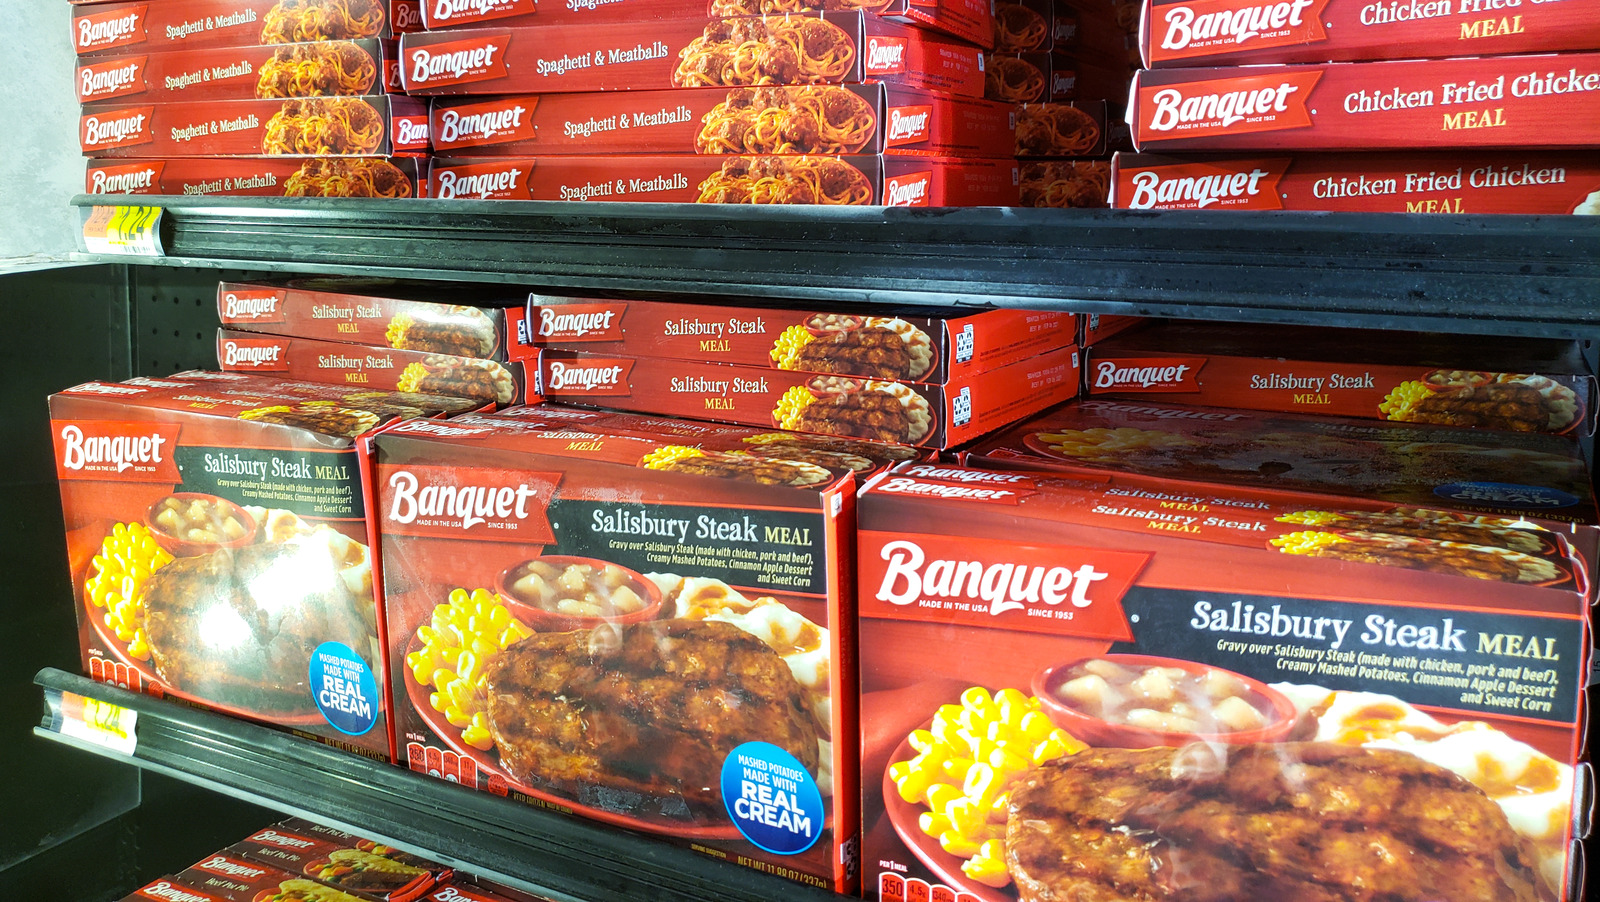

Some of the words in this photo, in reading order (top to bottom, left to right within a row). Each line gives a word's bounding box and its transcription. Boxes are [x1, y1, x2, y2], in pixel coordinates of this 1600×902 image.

[166, 20, 204, 40] Spaghetti
[206, 17, 213, 30] &
[215, 8, 257, 28] Meatballs
[1161, 0, 1314, 49] Banquet
[1360, 0, 1452, 26] Chicken
[79, 14, 138, 47] Banquet
[1458, 16, 1525, 40] MEAL
[412, 44, 498, 82] Banquet
[536, 53, 591, 77] Spaghetti
[594, 50, 605, 66] &
[608, 41, 668, 64] Meatballs
[867, 39, 903, 70] Banquet
[81, 64, 138, 96] Banquet
[165, 70, 201, 90] Spaghetti
[203, 69, 210, 81] &
[212, 61, 252, 79] Meatballs
[1344, 86, 1434, 114] Chicken
[1440, 75, 1505, 105] Fried
[1511, 68, 1600, 98] Chicke
[1149, 83, 1298, 131] Banquet
[1441, 109, 1507, 130] MEAL
[85, 114, 145, 144] Banquet
[171, 123, 208, 142] Spaghetti
[210, 123, 218, 134] &
[220, 114, 259, 131] Meatballs
[440, 106, 526, 142] Banquet
[564, 116, 616, 138] Spaghetti
[619, 114, 630, 129] &
[633, 105, 692, 127] Meatballs
[889, 110, 928, 139] Banquet
[92, 169, 155, 194] Banquet
[183, 178, 222, 195] Spaghetti
[224, 178, 231, 191] &
[234, 173, 276, 188] Meatballs
[438, 168, 522, 199] Banquet
[560, 181, 612, 201] Spaghetti
[615, 179, 626, 194] &
[629, 173, 688, 193] Meatballs
[888, 179, 927, 206] Banquet
[1129, 169, 1269, 209] Banquet
[1313, 175, 1396, 199] Chicken
[1404, 168, 1462, 193] Fried
[1469, 163, 1566, 188] Chicken
[1405, 198, 1465, 213] MEAL
[225, 294, 278, 318] Banquet
[312, 305, 354, 321] Salisbury
[356, 304, 382, 318] Steak
[337, 323, 359, 333] MEAL
[538, 308, 615, 337] Banquet
[664, 318, 725, 338] Salisbury
[728, 317, 766, 334] Steak
[225, 342, 281, 366] Banquet
[700, 340, 731, 352] MEAL
[318, 354, 363, 371] Salisbury
[366, 354, 394, 368] Steak
[1095, 361, 1190, 388] Banquet
[345, 373, 368, 382] MEAL
[549, 362, 623, 391] Banquet
[670, 376, 729, 397] Salisbury
[732, 377, 768, 393] Steak
[1250, 373, 1325, 393] Salisbury
[1328, 372, 1375, 388] Steak
[705, 398, 735, 410] MEAL
[1083, 400, 1255, 421] Banquet
[1293, 394, 1331, 404] MEAL
[62, 425, 166, 473] Banquet
[564, 442, 604, 450] MEAL
[204, 453, 267, 481] Salisbury
[271, 458, 312, 479] Steak
[315, 465, 350, 480] MEAL
[907, 466, 1030, 482] Banquet
[389, 471, 537, 530] Banquet
[877, 478, 1015, 499] Banquet
[1105, 488, 1205, 504] Salisbury
[1211, 498, 1270, 510] Steak
[1091, 505, 1198, 525] Salisbury
[1203, 517, 1267, 532] Steak
[1159, 501, 1210, 512] MEAL
[591, 508, 690, 543] Salisbury
[695, 515, 758, 542] Steak
[764, 526, 813, 546] MEAL
[1147, 521, 1201, 534] MEAL
[647, 553, 671, 565] Creamy
[672, 555, 696, 565] Mashed
[697, 557, 728, 568] Potatoes,
[729, 560, 762, 571] Cinnamon
[762, 563, 783, 574] Apple
[784, 564, 812, 575] Dessert
[757, 574, 770, 583] and
[771, 574, 792, 585] Sweet
[793, 576, 811, 586] Corn
[875, 540, 1109, 616] Banquet
[919, 600, 942, 608] MADE
[955, 602, 970, 610] THE
[972, 604, 988, 612] USA
[1027, 608, 1052, 618] SINCE
[1054, 611, 1074, 620] 1953
[1190, 601, 1353, 649] Salisbury
[1360, 614, 1467, 652] Steak
[1476, 632, 1560, 661] MEAL
[319, 653, 339, 666] MASHED
[340, 658, 364, 672] POTATOES
[323, 664, 342, 677] MADE
[343, 669, 360, 683] WITH
[1217, 639, 1248, 654] Gravy
[1249, 643, 1272, 654] over
[1274, 644, 1324, 661] Salisbury
[1325, 649, 1356, 663] Steak
[1358, 651, 1391, 666] (made
[1393, 656, 1417, 669] with
[1419, 658, 1464, 674] chicken,
[1466, 663, 1496, 677] pork
[1497, 666, 1521, 679] and
[1522, 668, 1559, 684] beef),
[323, 675, 366, 701] REAL
[1276, 658, 1317, 675] Creamy
[1317, 662, 1357, 677] Mashed
[1358, 665, 1410, 683] Potatoes,
[1413, 672, 1469, 689] Cinnamon
[1470, 678, 1506, 693] Apple
[1508, 682, 1557, 698] Dessert
[320, 690, 371, 720] CREAM
[1460, 691, 1483, 704] and
[1484, 693, 1519, 709] Sweet
[1522, 697, 1552, 712] Corn
[738, 754, 767, 771] MASHED
[769, 762, 804, 782] POTATOES
[743, 767, 770, 785] MADE
[772, 775, 797, 794] WITH
[741, 780, 805, 816] REAL
[734, 798, 811, 837] CREAM
[253, 830, 315, 848] Banquet
[200, 856, 266, 877] Banquet
[890, 861, 894, 870] 1
[895, 863, 908, 872] MEAL
[882, 879, 903, 896] 350
